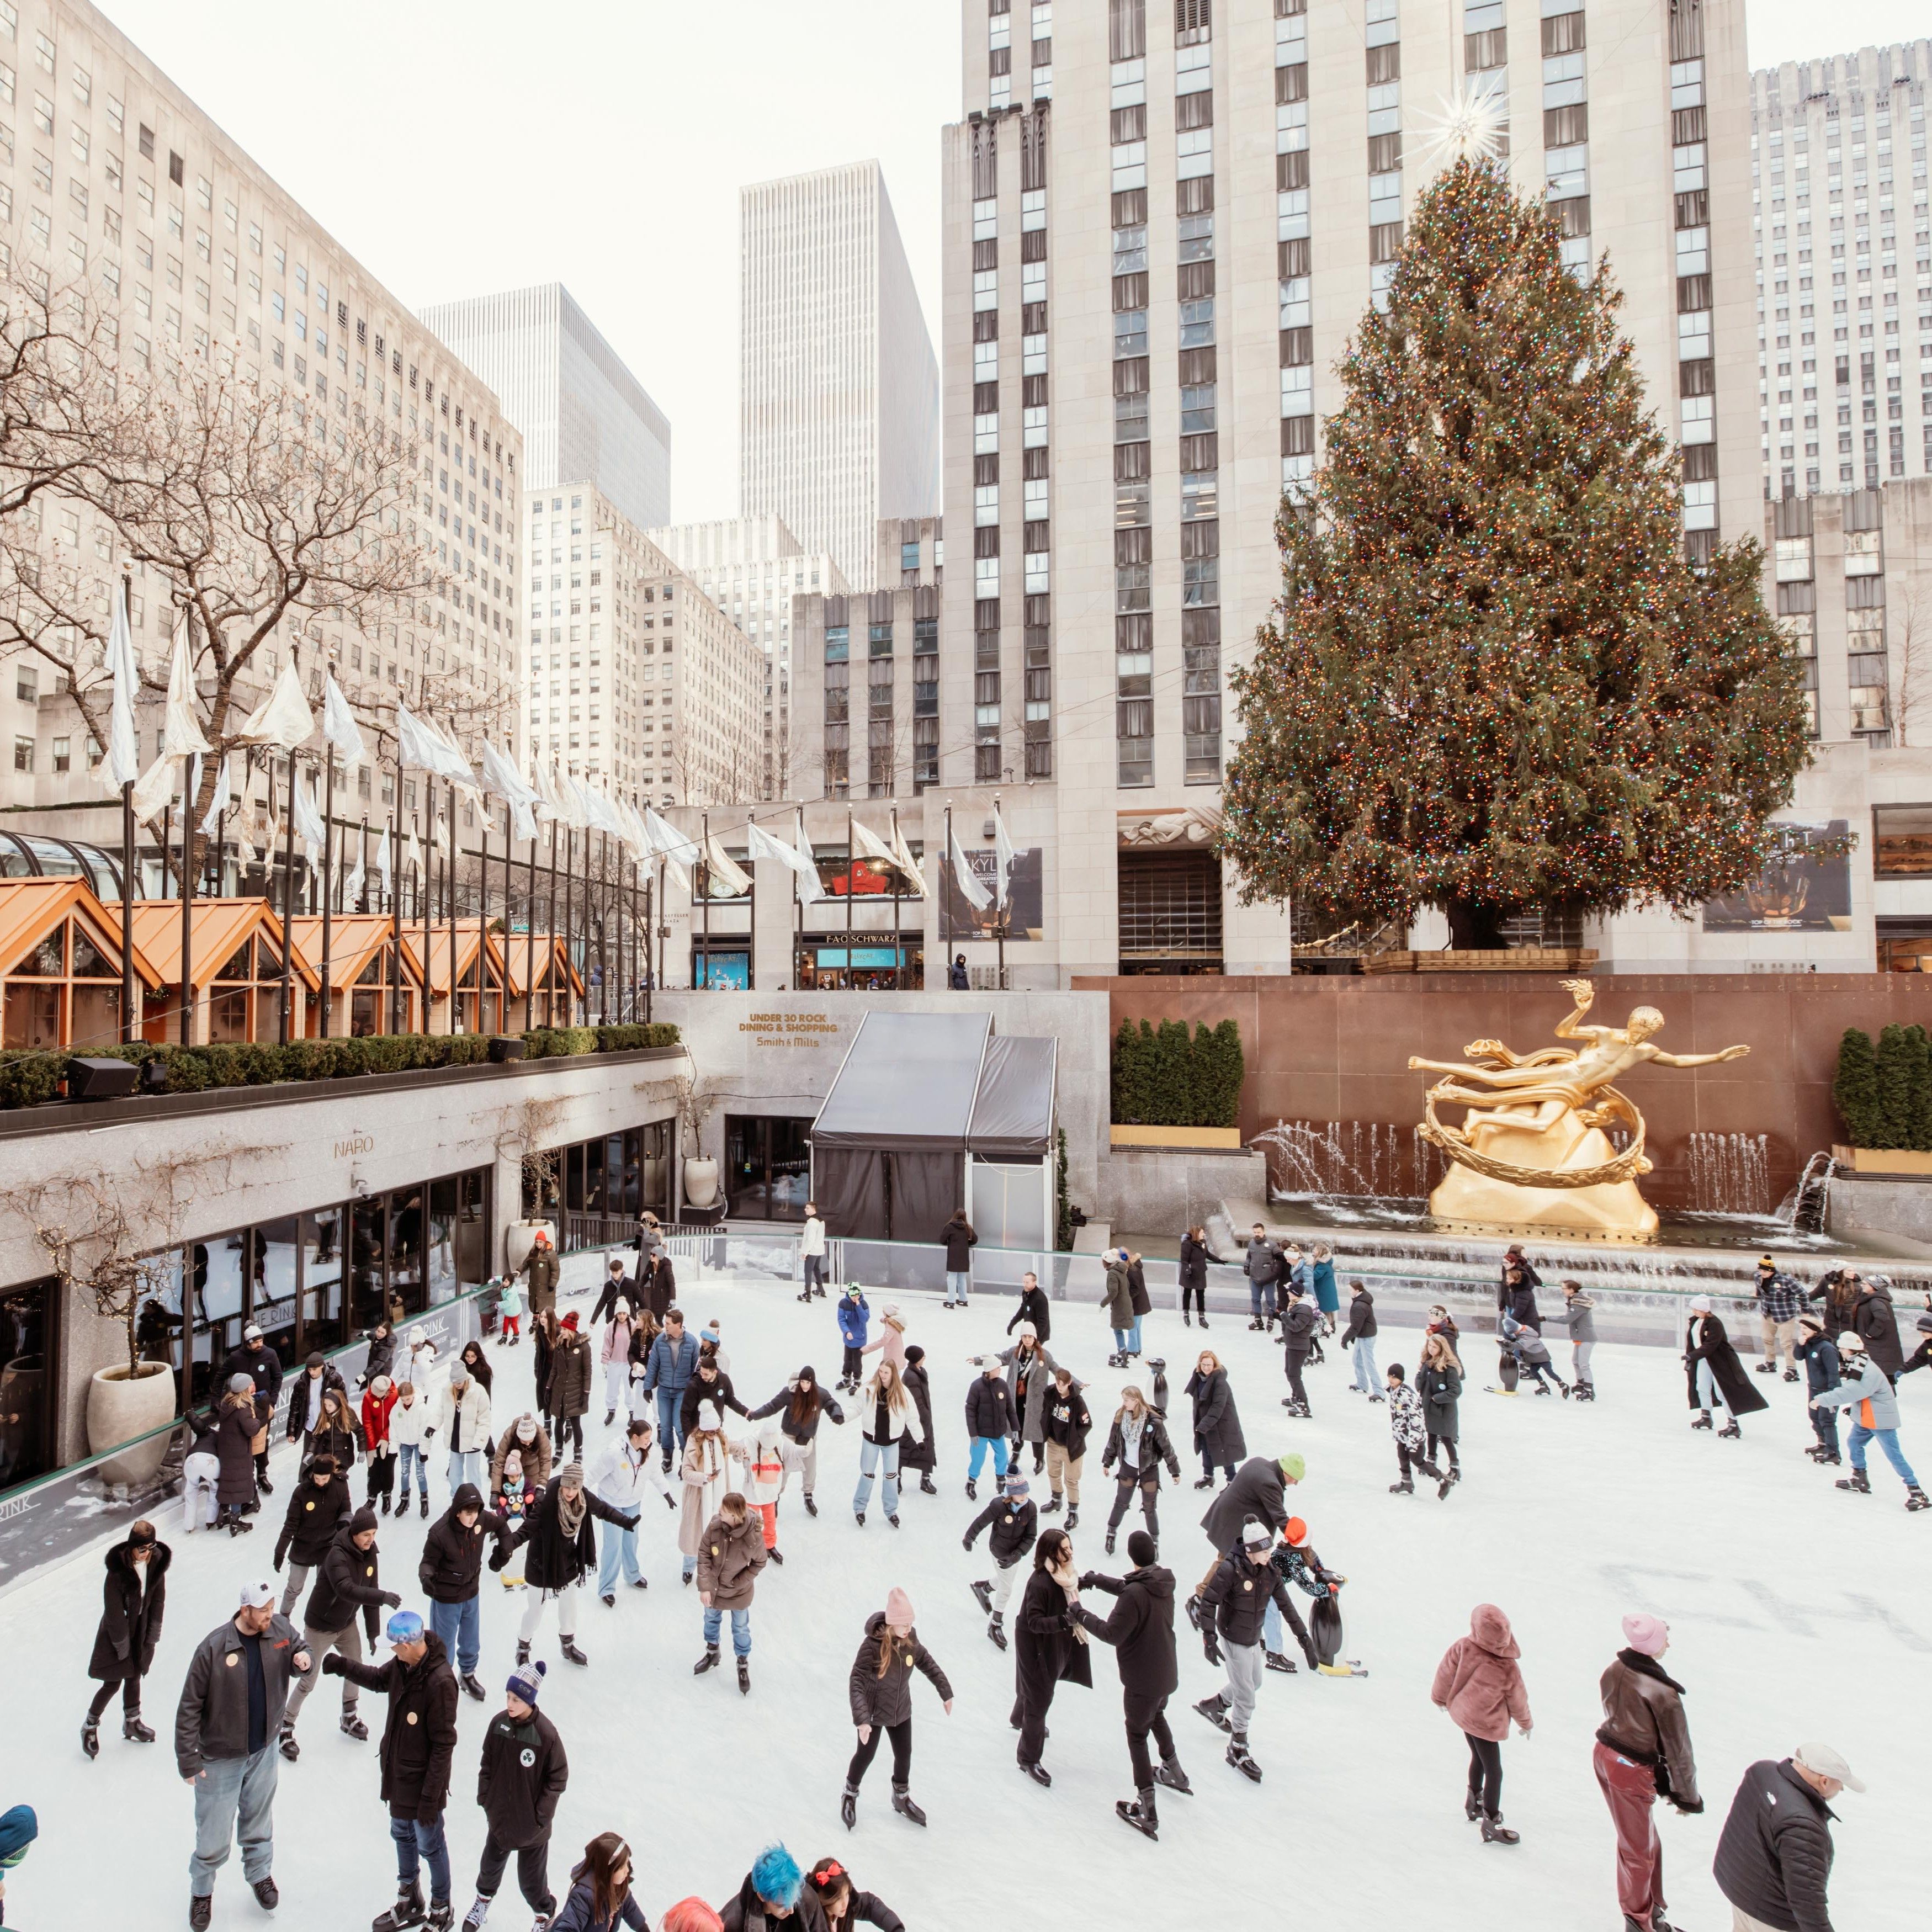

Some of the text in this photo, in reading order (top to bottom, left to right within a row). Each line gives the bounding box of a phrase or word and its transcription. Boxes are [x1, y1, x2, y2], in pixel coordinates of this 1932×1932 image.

[966, 857, 1017, 872] KYLT
[750, 1013, 782, 1022] UNDER
[798, 1014, 826, 1022] ROCK
[739, 1023, 773, 1032] DINING
[786, 1024, 838, 1032] SHOPPING
[757, 1037, 784, 1047] Smith
[794, 1038, 820, 1047] Mills
[334, 1136, 373, 1159] NARO
[270, 1303, 296, 1325] RINK
[424, 1316, 445, 1339] RINK
